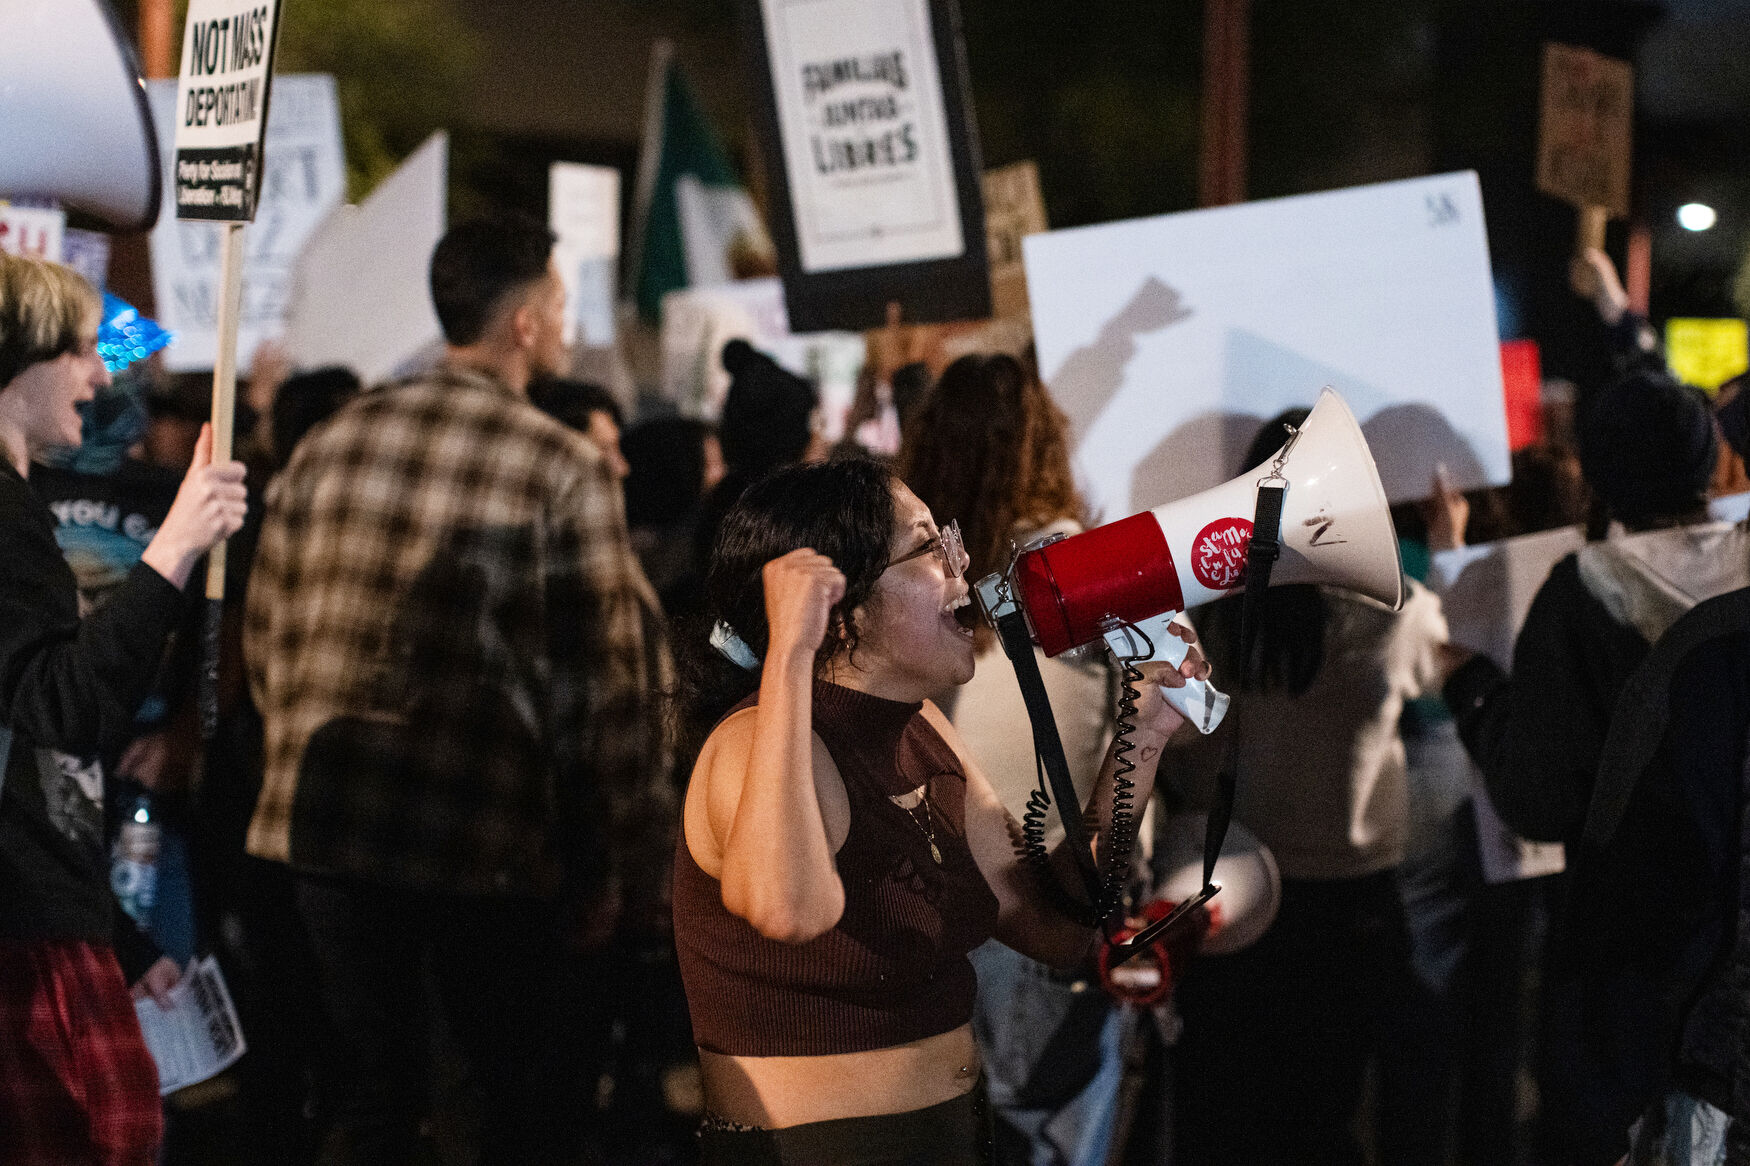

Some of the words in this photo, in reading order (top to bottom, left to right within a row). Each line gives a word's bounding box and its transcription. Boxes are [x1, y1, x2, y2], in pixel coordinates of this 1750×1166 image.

[190, 17, 229, 76] NOT
[230, 5, 267, 72] MASS
[810, 122, 918, 174] LIBRES
[49, 498, 120, 530] YOU
